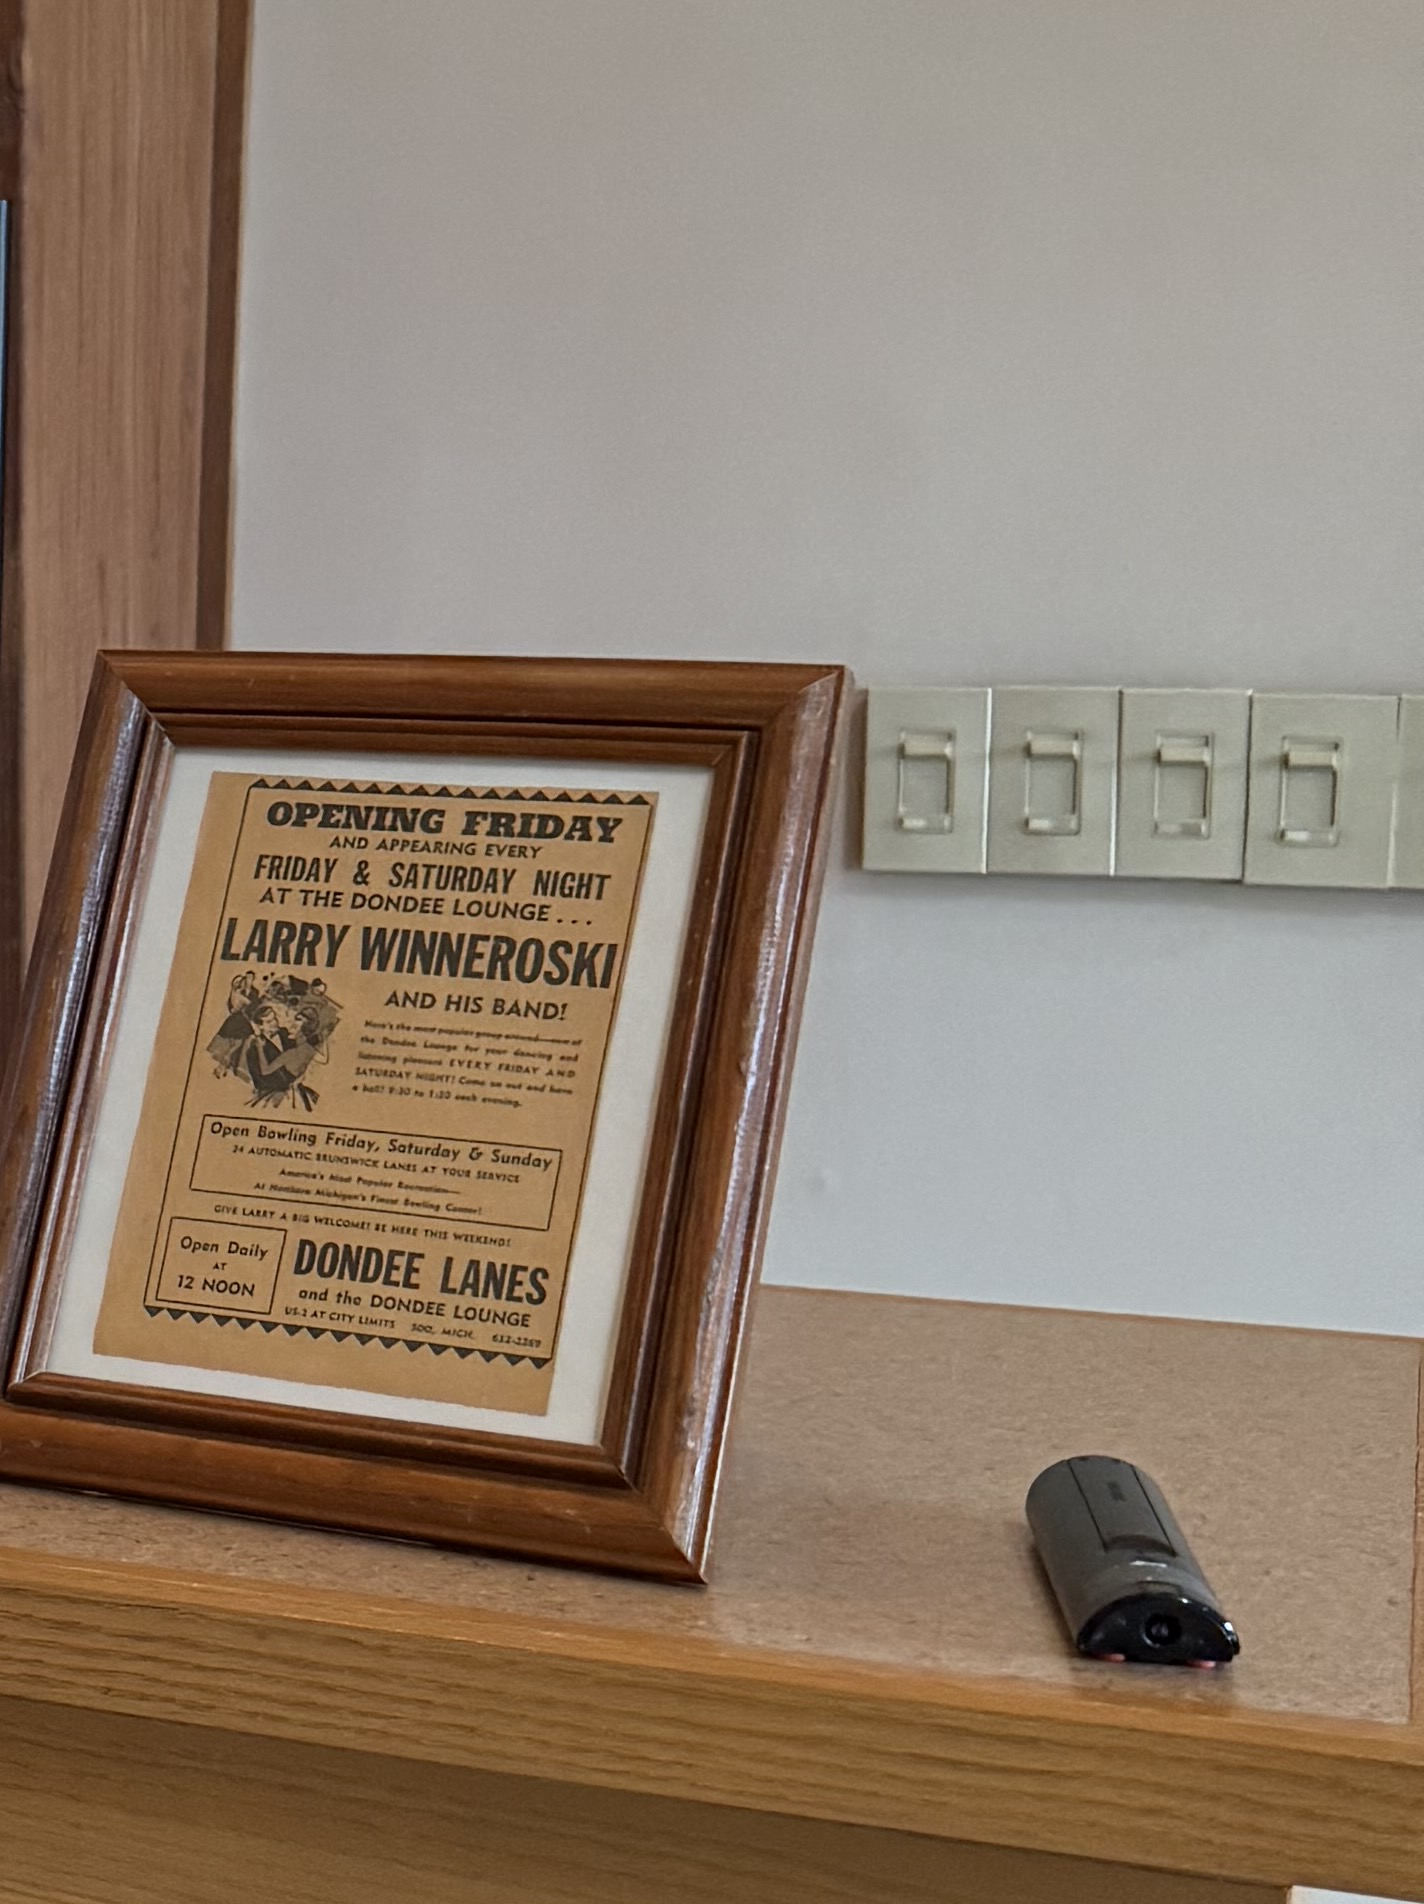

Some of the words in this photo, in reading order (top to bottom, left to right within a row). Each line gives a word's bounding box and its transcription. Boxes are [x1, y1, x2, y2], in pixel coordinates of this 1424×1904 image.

[267, 801, 446, 835] OPENING
[461, 810, 623, 844] FRIDAY
[329, 835, 368, 851] AND
[376, 838, 476, 857] APPEARING
[485, 843, 544, 860] EVERY
[254, 854, 338, 884] FRIDAY
[352, 860, 370, 886] &
[388, 862, 517, 896] SATURDAY
[533, 869, 612, 901] NIGHT
[259, 886, 289, 905] AT
[299, 889, 344, 910] THE
[351, 893, 444, 915] DONDEE
[220, 917, 351, 967] LARRY
[360, 926, 618, 989] WINNEROSKI
[384, 990, 436, 1009] AND
[444, 994, 483, 1013] HIS
[491, 998, 568, 1021] BAND!
[360, 1035, 375, 1044] the
[382, 1036, 417, 1047] Dondee
[423, 1040, 457, 1052] Lounge
[559, 1053, 579, 1062] and
[355, 1067, 412, 1079] SATURDAY
[449, 1058, 492, 1070] EVERY
[497, 1063, 540, 1074] FRIDAY
[545, 1069, 576, 1078] AND
[211, 1121, 249, 1138] Open
[257, 1125, 317, 1146] Bowling
[325, 1132, 380, 1152] Friday,
[387, 1138, 460, 1162] Saturday
[469, 1147, 483, 1161] &
[491, 1149, 552, 1172] Sunday
[232, 1145, 244, 1154] 24
[248, 1146, 312, 1161] AUTOMATIC
[316, 1153, 380, 1168] BRUNSWICK
[384, 1160, 417, 1172] LANES
[421, 1166, 437, 1174] AT
[442, 1167, 471, 1178] YOUR
[475, 1170, 520, 1183] SERVICE
[279, 1168, 324, 1180] America's
[403, 1197, 441, 1212] Bowling
[214, 1204, 238, 1215] GIVE
[242, 1207, 276, 1219] LARRY
[280, 1212, 287, 1221] A
[292, 1213, 310, 1223] BIG
[374, 1223, 386, 1232] BE
[391, 1225, 418, 1236] HERE
[424, 1229, 448, 1240] THIS
[180, 1236, 219, 1253] Open
[227, 1241, 269, 1261] Daily
[212, 1262, 228, 1271] AT
[293, 1239, 425, 1290] DONDEE
[439, 1257, 550, 1306] LANES
[177, 1275, 195, 1290] 12
[202, 1278, 255, 1297] NOON
[284, 1306, 307, 1317] US-2
[310, 1310, 326, 1318] AT
[329, 1312, 354, 1323] CITY
[358, 1316, 395, 1329] LIMITS
[299, 1288, 329, 1301] and
[336, 1290, 362, 1306] the
[370, 1294, 446, 1317] DONDEE
[453, 1305, 531, 1328] LOUNGE
